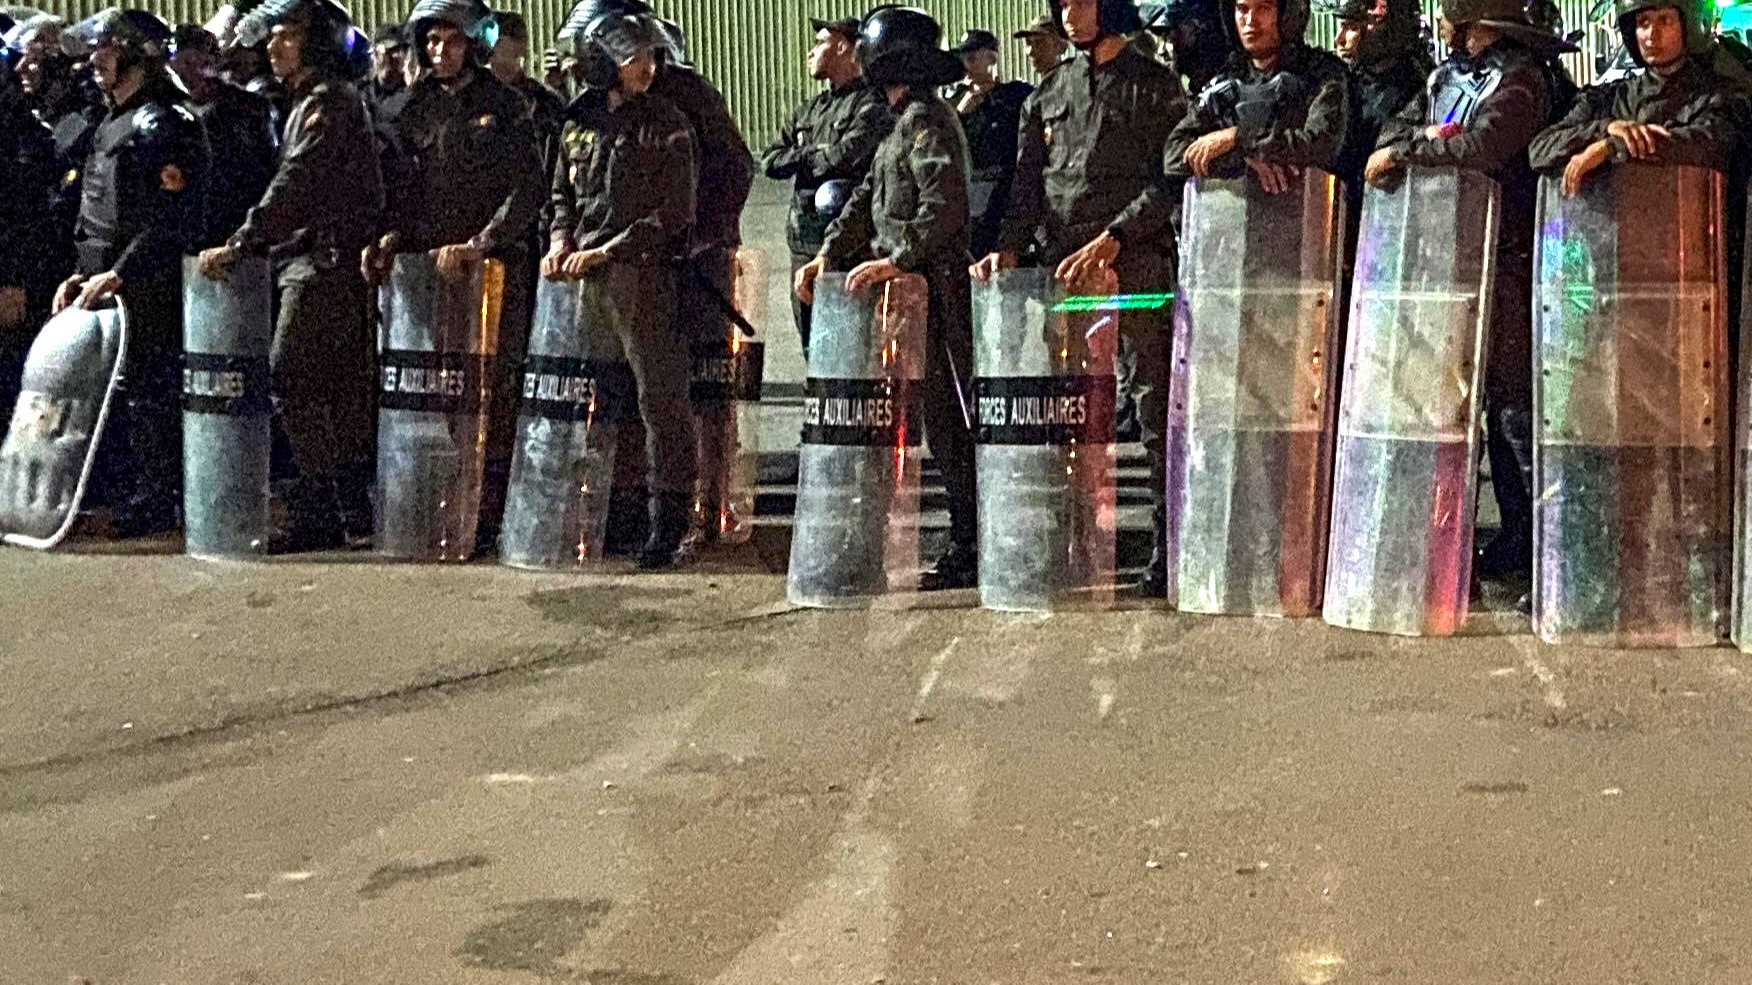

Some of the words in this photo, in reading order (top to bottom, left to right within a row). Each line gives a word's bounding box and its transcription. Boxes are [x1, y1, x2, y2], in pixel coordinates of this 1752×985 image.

[399, 368, 465, 396] AUXILIAIRES
[536, 374, 598, 405] AUXILIAIRES
[823, 397, 893, 427] AUXILIAIRES
[1011, 395, 1087, 426] AUXILIAIRES
